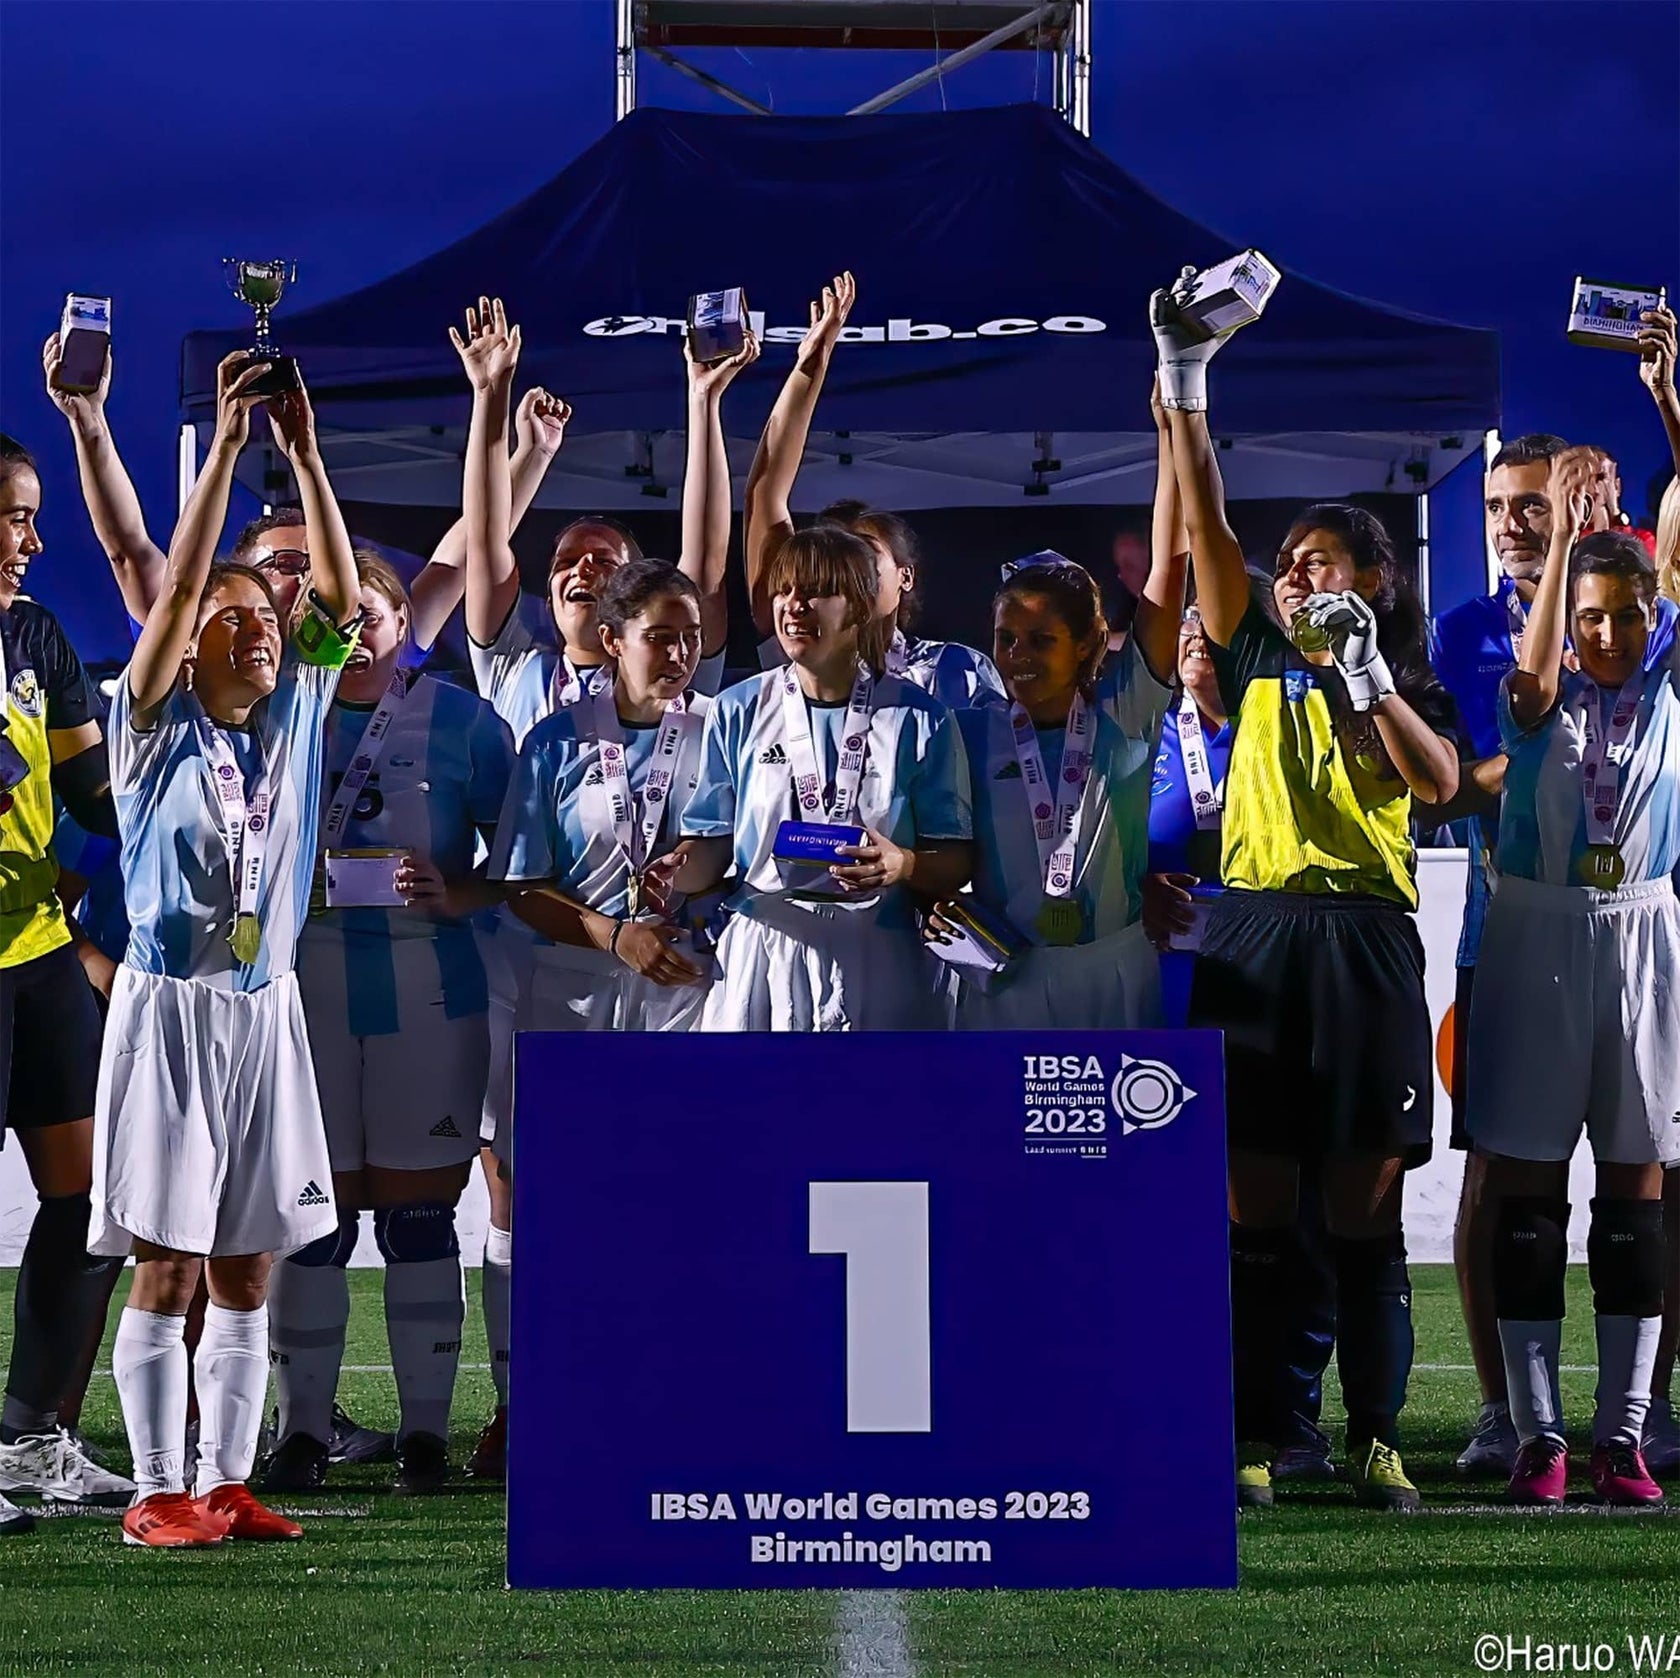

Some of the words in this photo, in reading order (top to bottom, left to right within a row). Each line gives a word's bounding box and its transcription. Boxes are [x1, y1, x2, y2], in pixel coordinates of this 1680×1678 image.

[1023, 1056, 1105, 1080] IBSA
[1025, 1081, 1060, 1092] World
[1063, 1081, 1105, 1092] Games
[1024, 1093, 1106, 1108] Birmingham
[1024, 1108, 1106, 1134] 2023
[809, 1182, 931, 1432] 1
[651, 1493, 737, 1521] IBSA
[744, 1492, 858, 1521] World
[866, 1492, 998, 1521] Games
[1004, 1490, 1091, 1521] 2023
[750, 1532, 992, 1573] Birmingham
